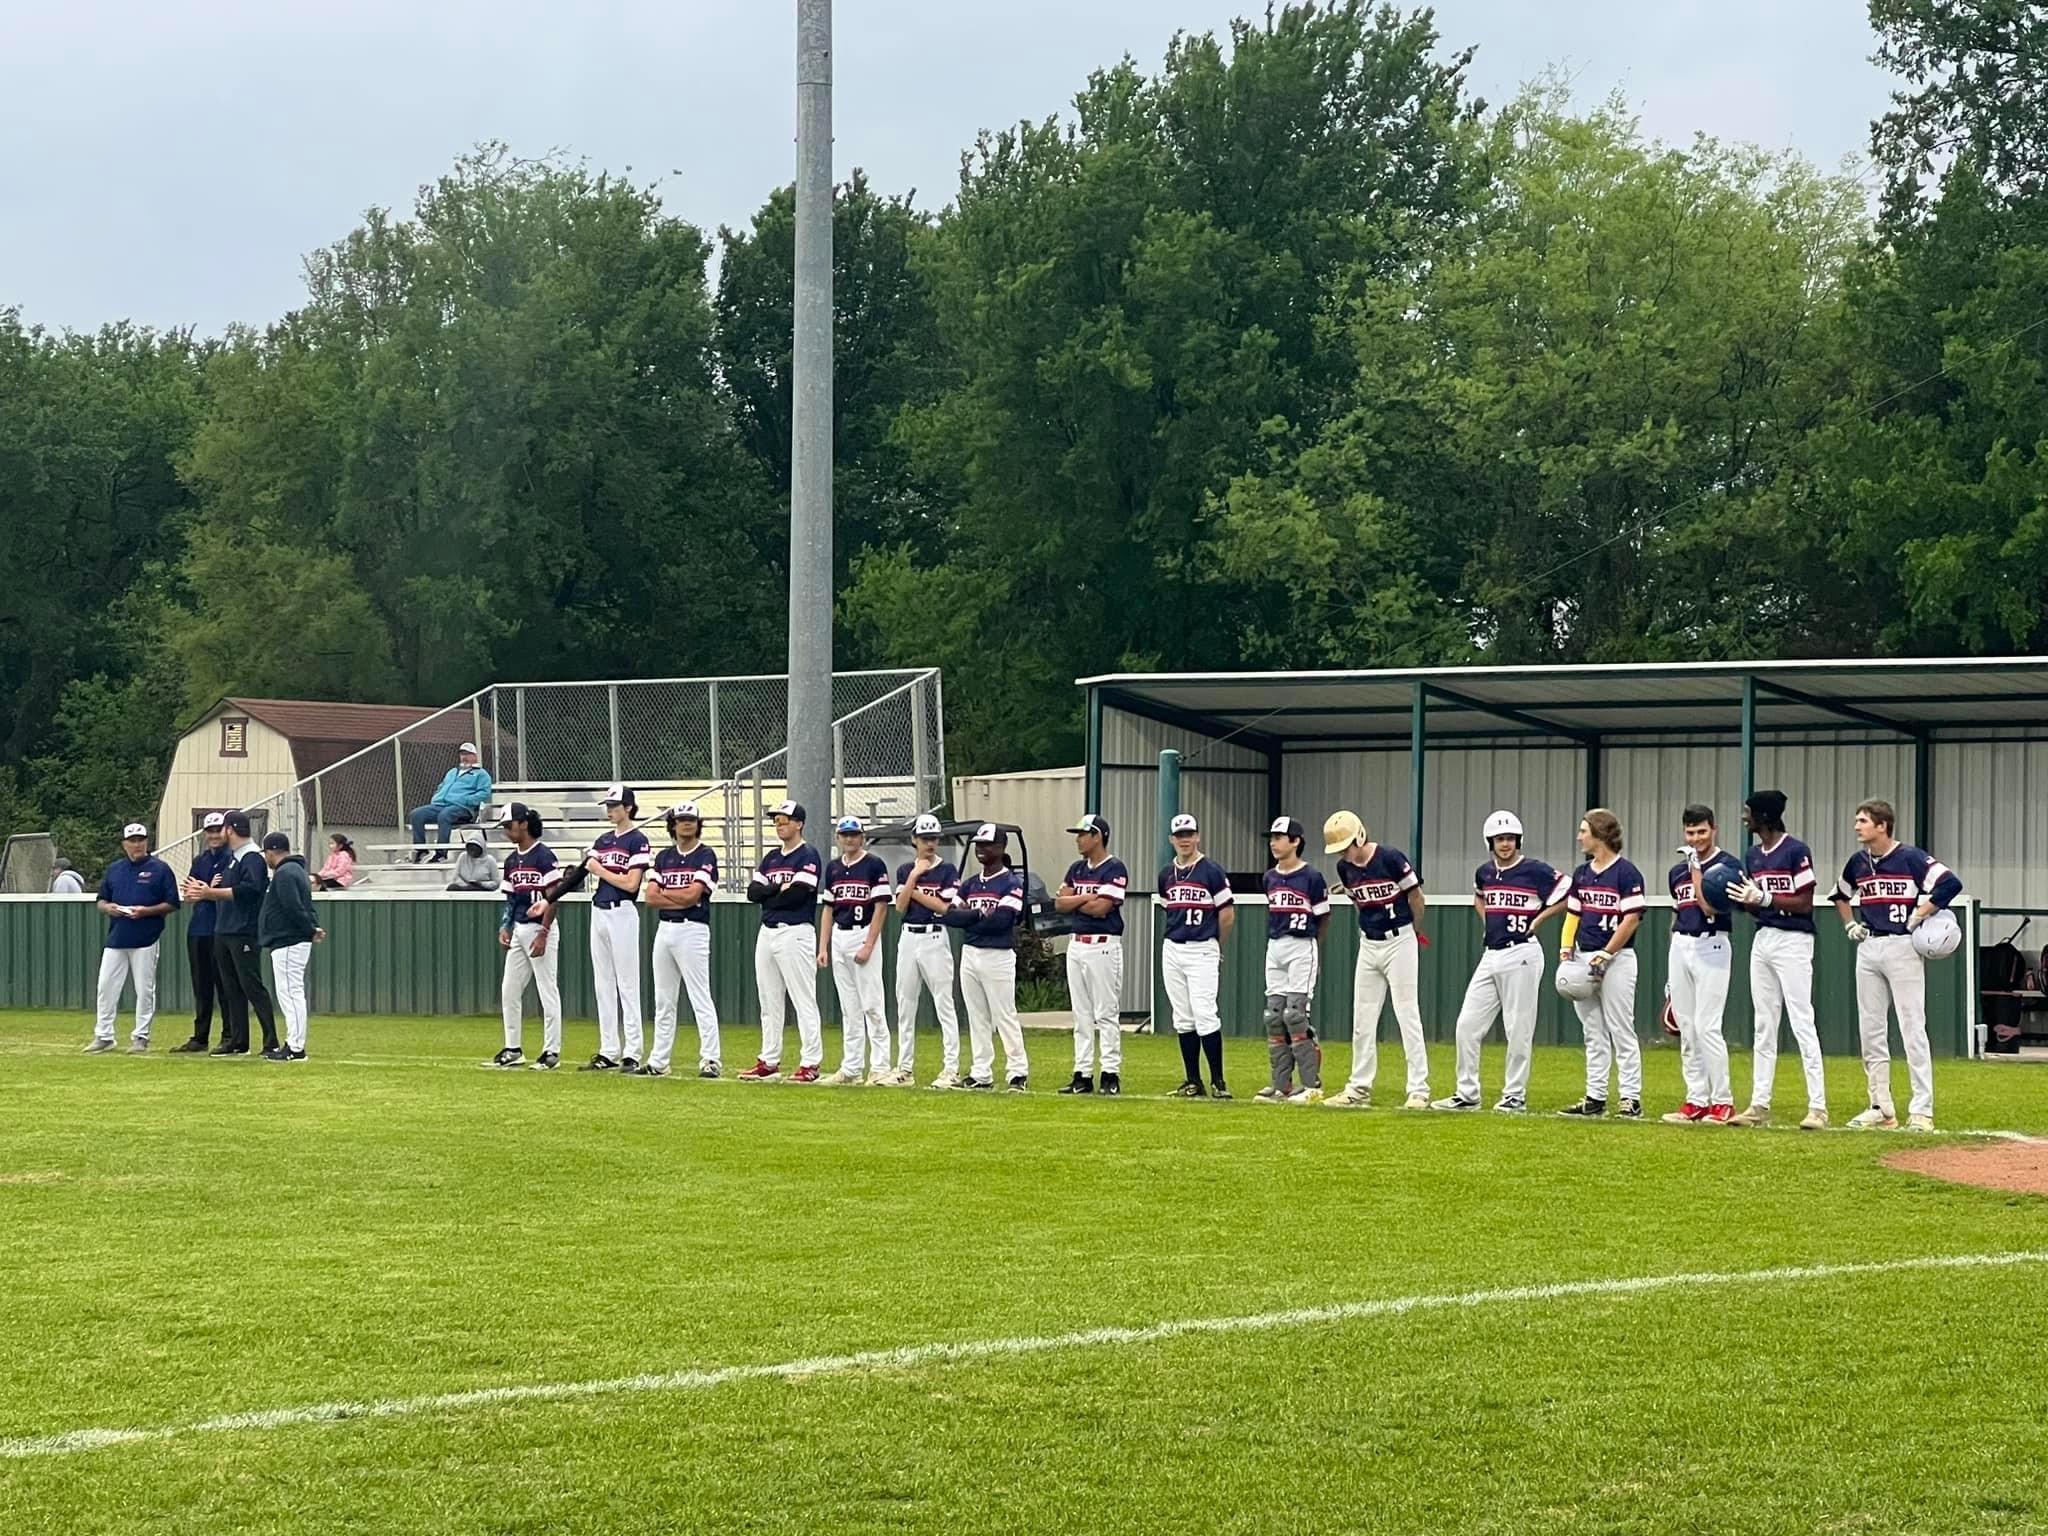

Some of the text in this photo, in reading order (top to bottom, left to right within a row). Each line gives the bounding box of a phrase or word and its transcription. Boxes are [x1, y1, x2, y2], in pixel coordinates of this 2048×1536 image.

[846, 886, 869, 898] PREP
[1180, 888, 1206, 901] PREP
[1367, 883, 1395, 899] PREP
[1879, 882, 1907, 896] PREP
[1499, 893, 1529, 907] PREP
[1593, 893, 1617, 906] PREP
[854, 905, 864, 921] 9
[1185, 908, 1203, 925] 13
[1385, 903, 1397, 919] 7
[1290, 913, 1308, 930] 22
[1506, 914, 1528, 933] 35
